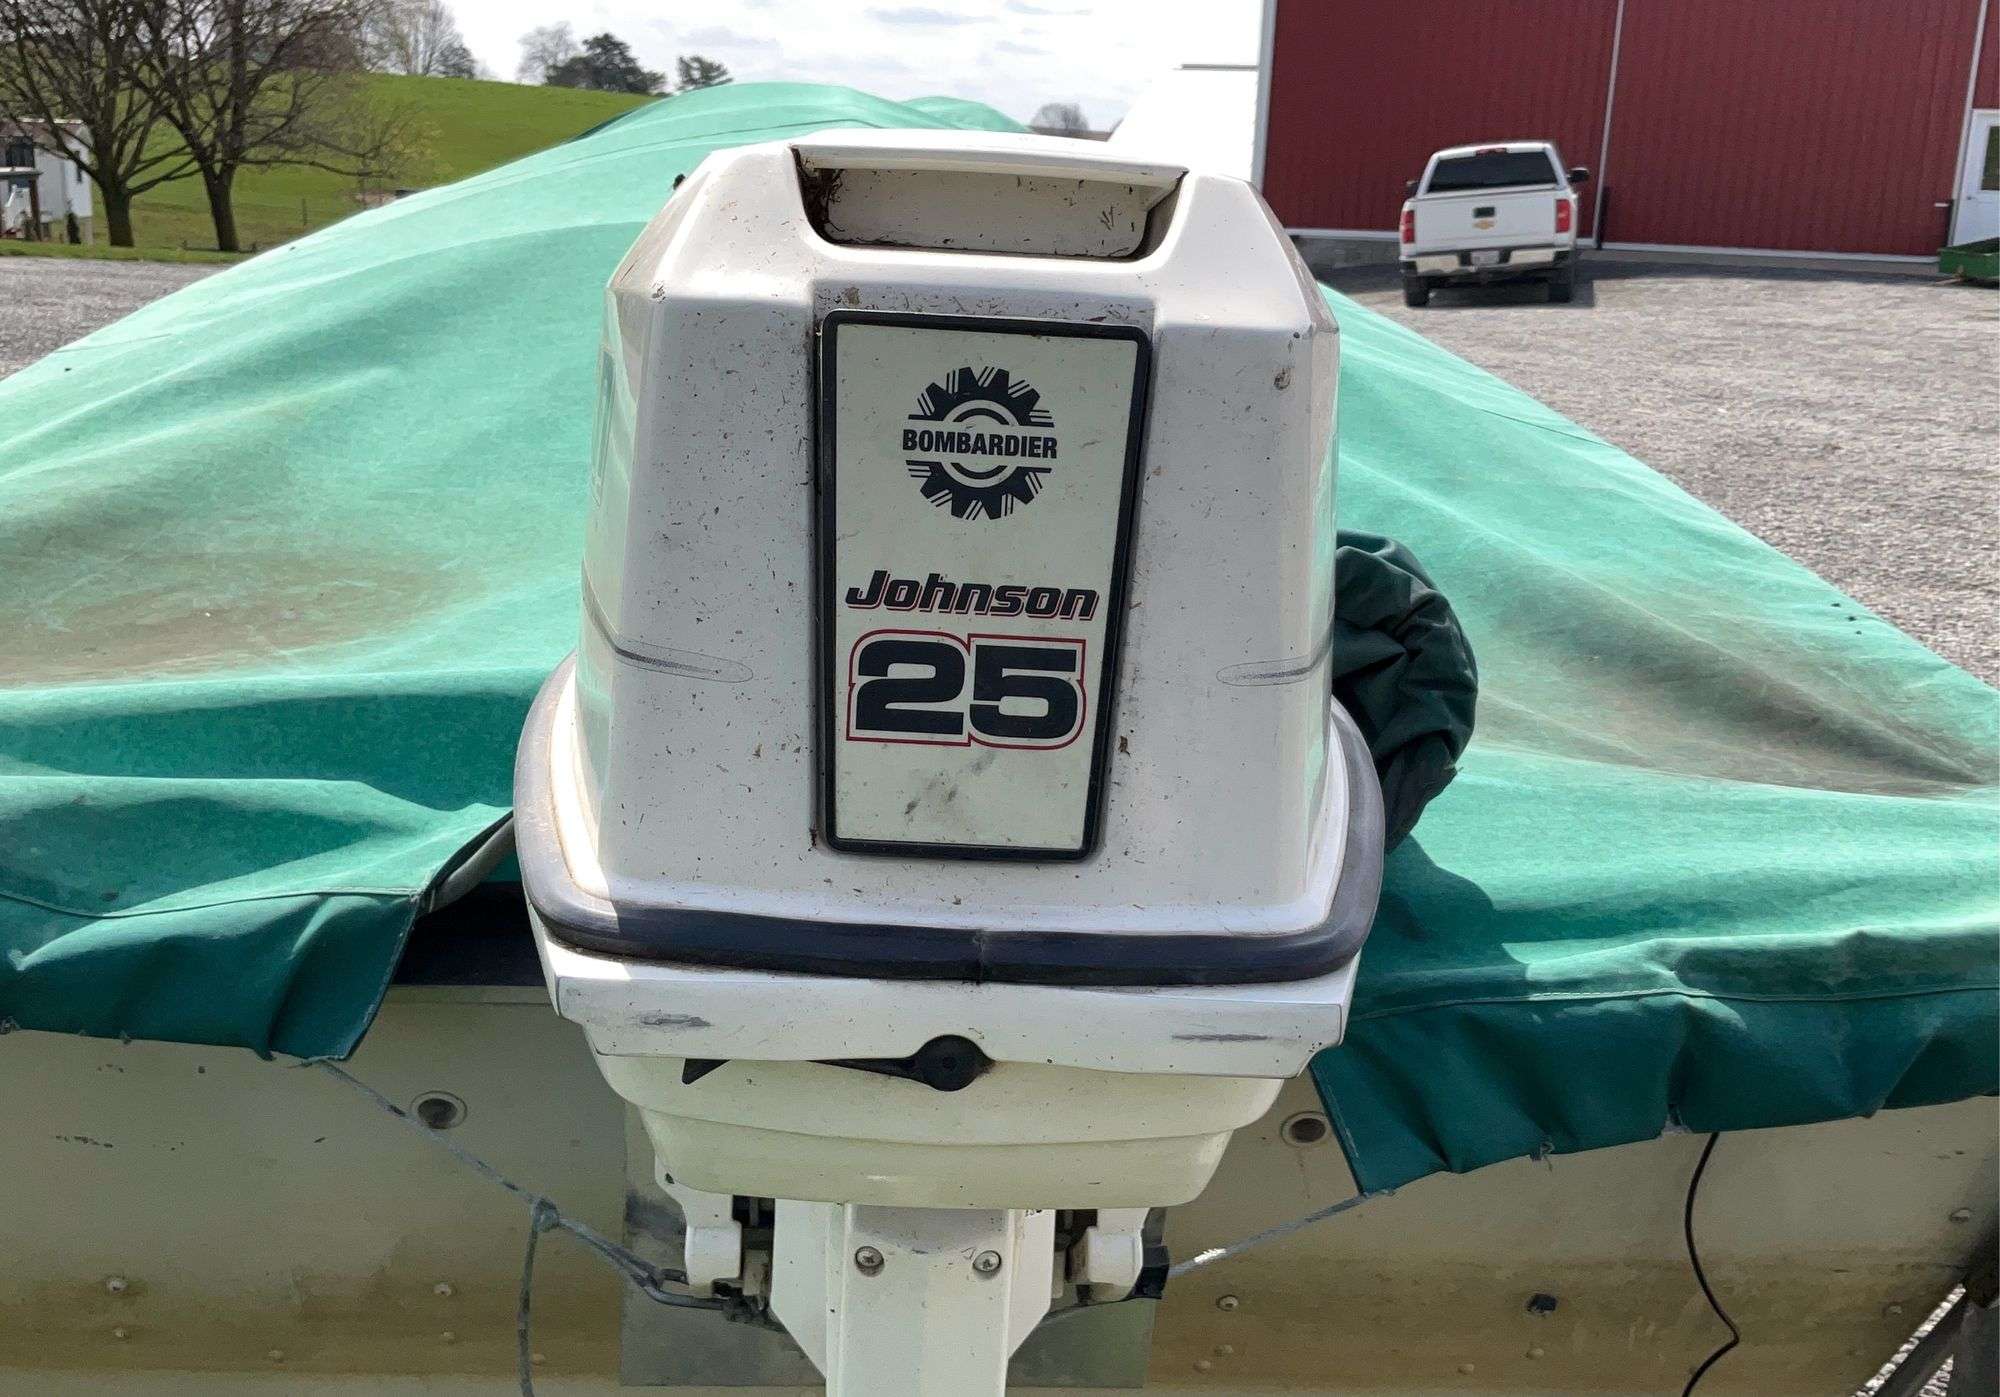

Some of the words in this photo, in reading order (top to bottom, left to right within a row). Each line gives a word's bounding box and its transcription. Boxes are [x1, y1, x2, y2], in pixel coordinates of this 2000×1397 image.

[903, 429, 1057, 459] BOMBARDIER
[846, 569, 1099, 620] Johnson
[854, 639, 1079, 740] 25
